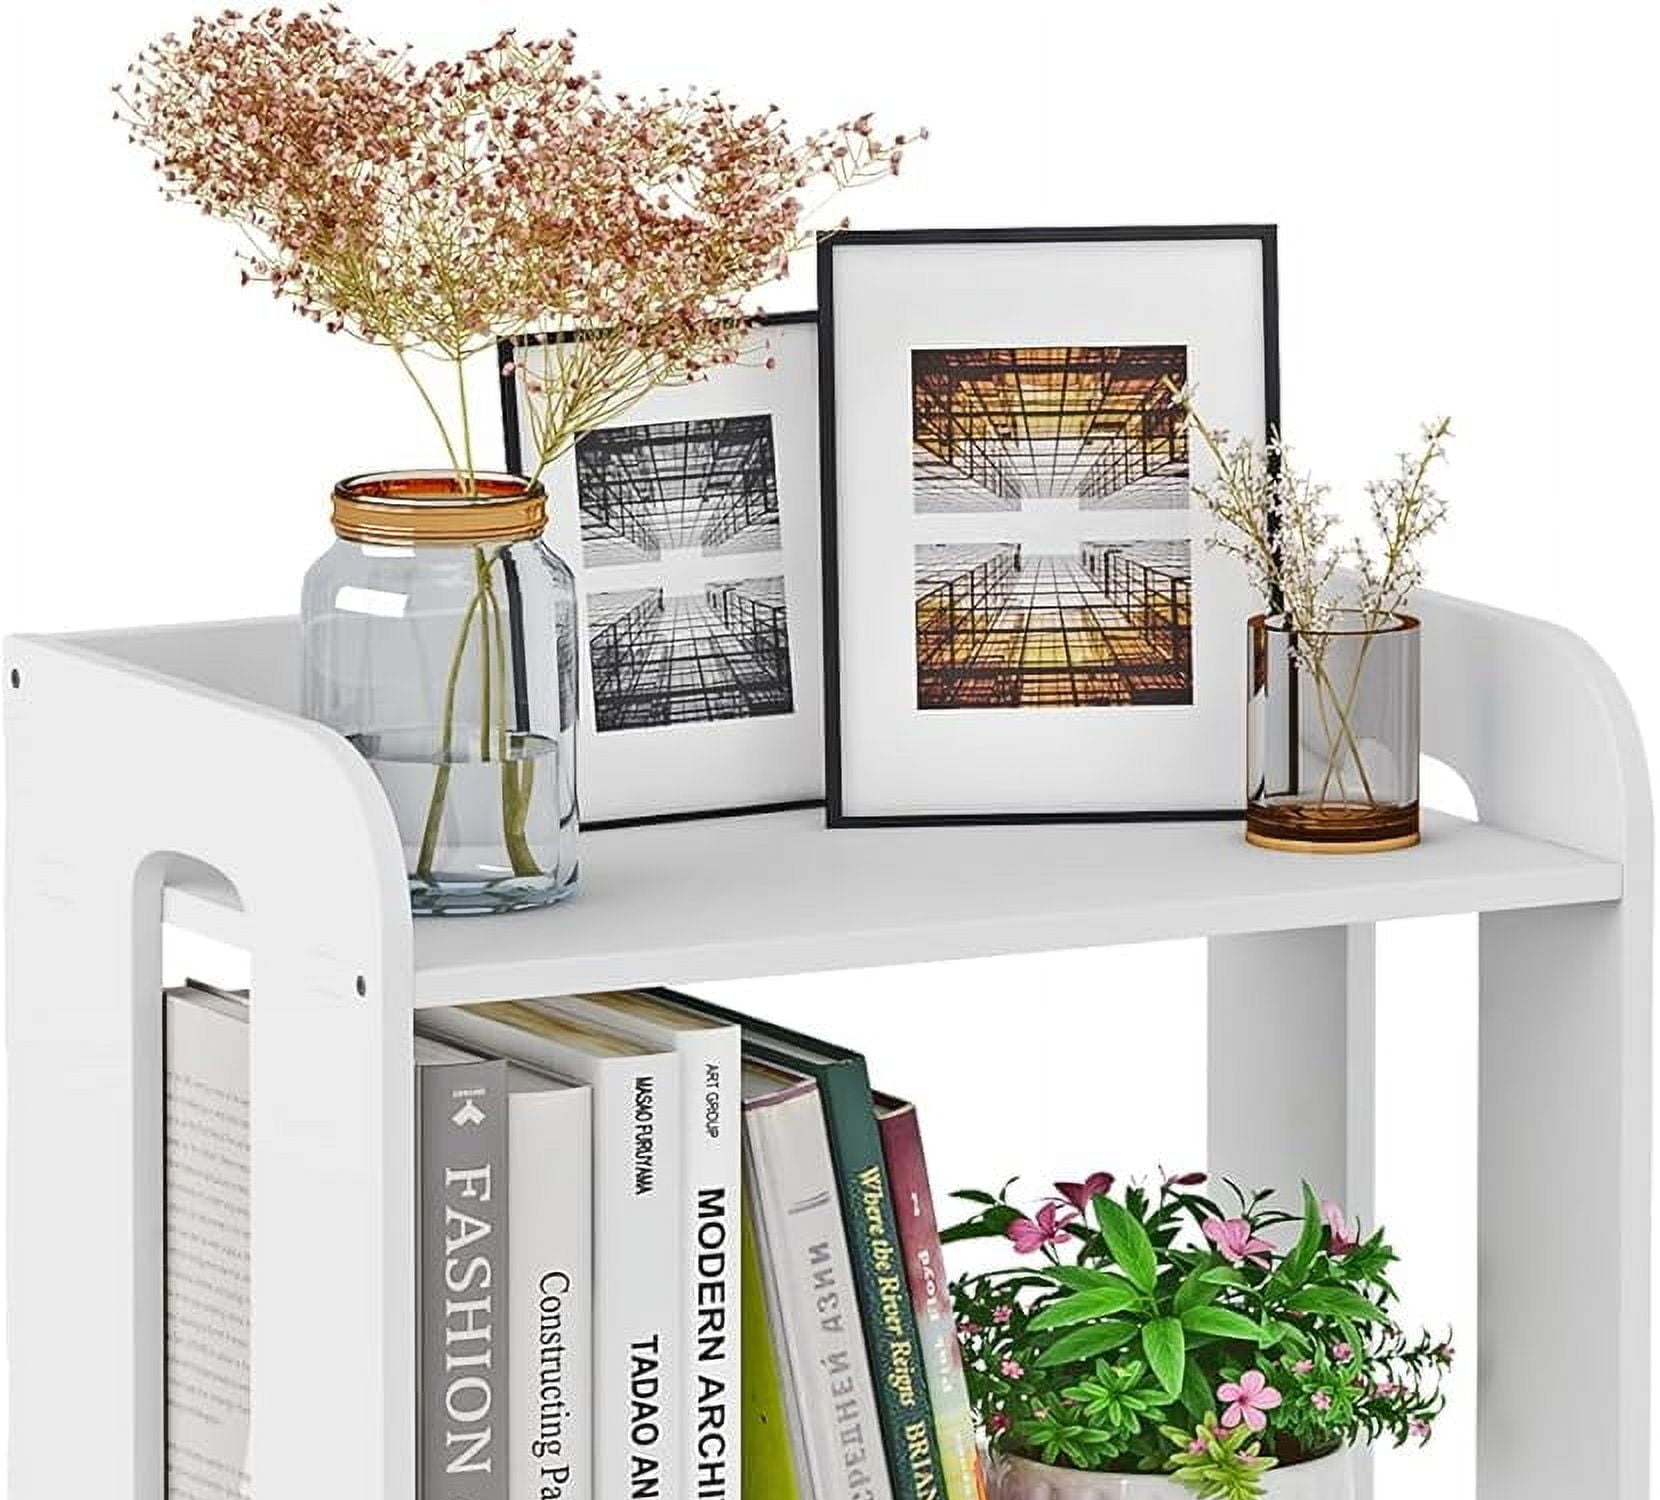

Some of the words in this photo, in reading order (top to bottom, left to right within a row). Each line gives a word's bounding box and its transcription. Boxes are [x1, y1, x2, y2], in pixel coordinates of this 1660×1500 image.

[704, 1063, 719, 1089] ART
[704, 1091, 719, 1139] GROUP
[858, 1166, 885, 1237] Where
[697, 1188, 726, 1362] MODERN
[808, 1241, 844, 1333] АЗИИ
[872, 1239, 894, 1272] the
[445, 1163, 492, 1473] FASHION
[878, 1276, 903, 1338] River
[531, 1271, 570, 1458] Constructing
[630, 1333, 659, 1446] TADAO
[888, 1340, 916, 1408] Reigns
